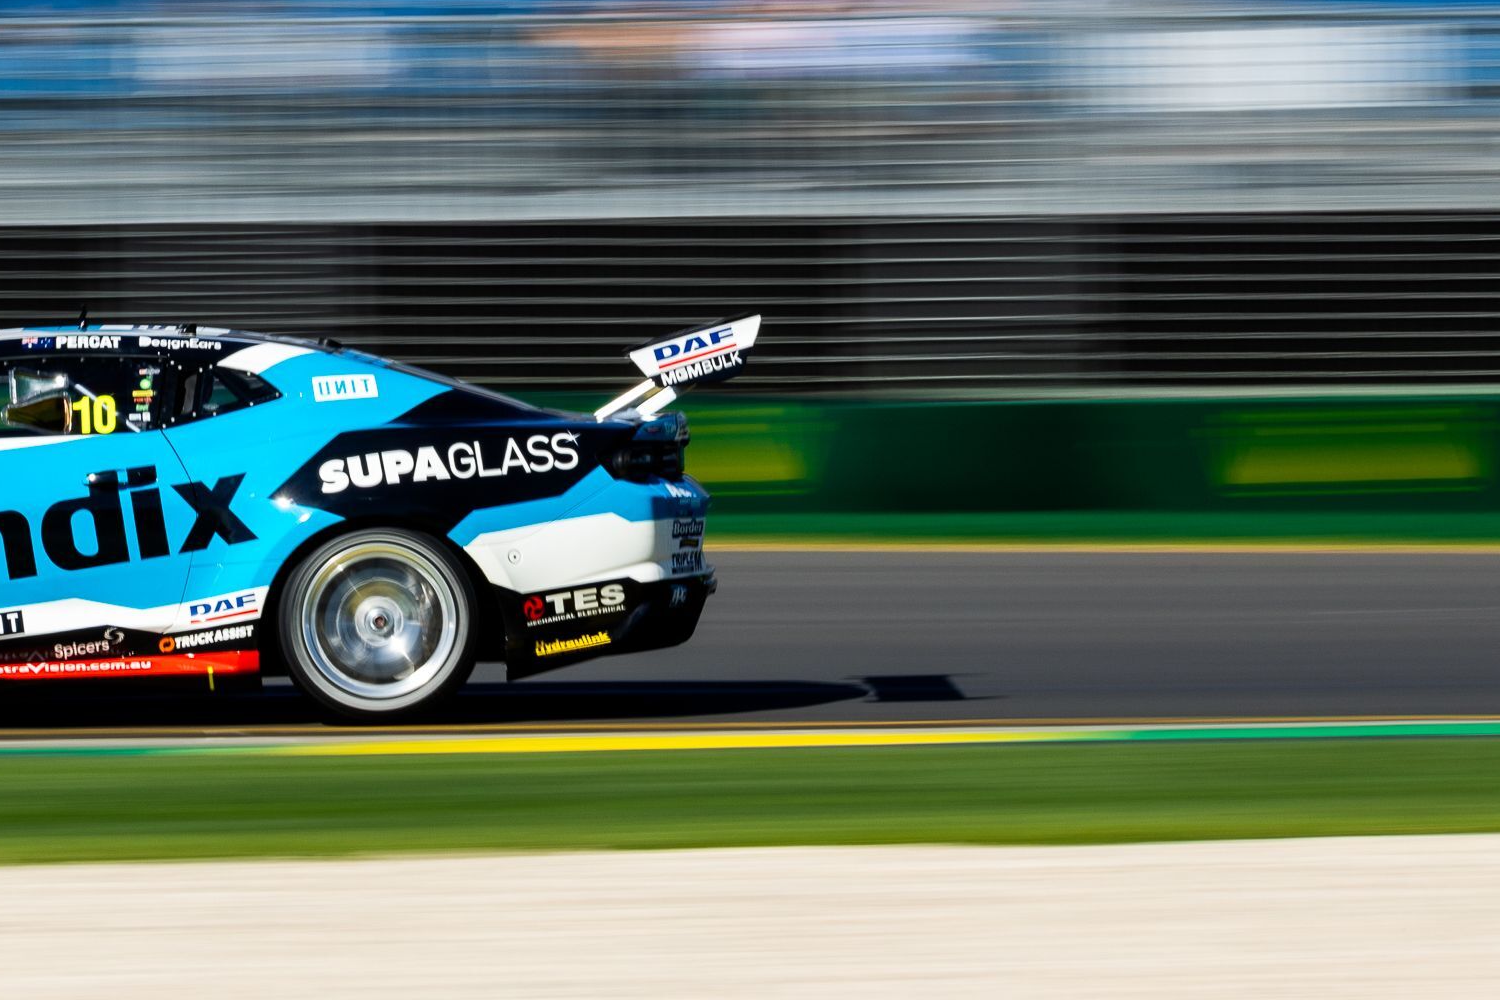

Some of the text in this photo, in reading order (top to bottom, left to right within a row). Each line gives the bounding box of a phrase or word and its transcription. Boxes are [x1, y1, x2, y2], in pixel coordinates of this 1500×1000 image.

[55, 335, 122, 349] PERCAT
[653, 327, 734, 361] DAF
[660, 351, 743, 387] MGMBULK
[318, 378, 370, 396] UNIT
[72, 395, 117, 434] 10
[318, 431, 580, 494] SUPAGLASS
[190, 592, 256, 616] DAF
[545, 583, 625, 614] TES
[527, 604, 626, 628] MECHANICAL ELECTRICAL
[54, 638, 110, 660] Spicers
